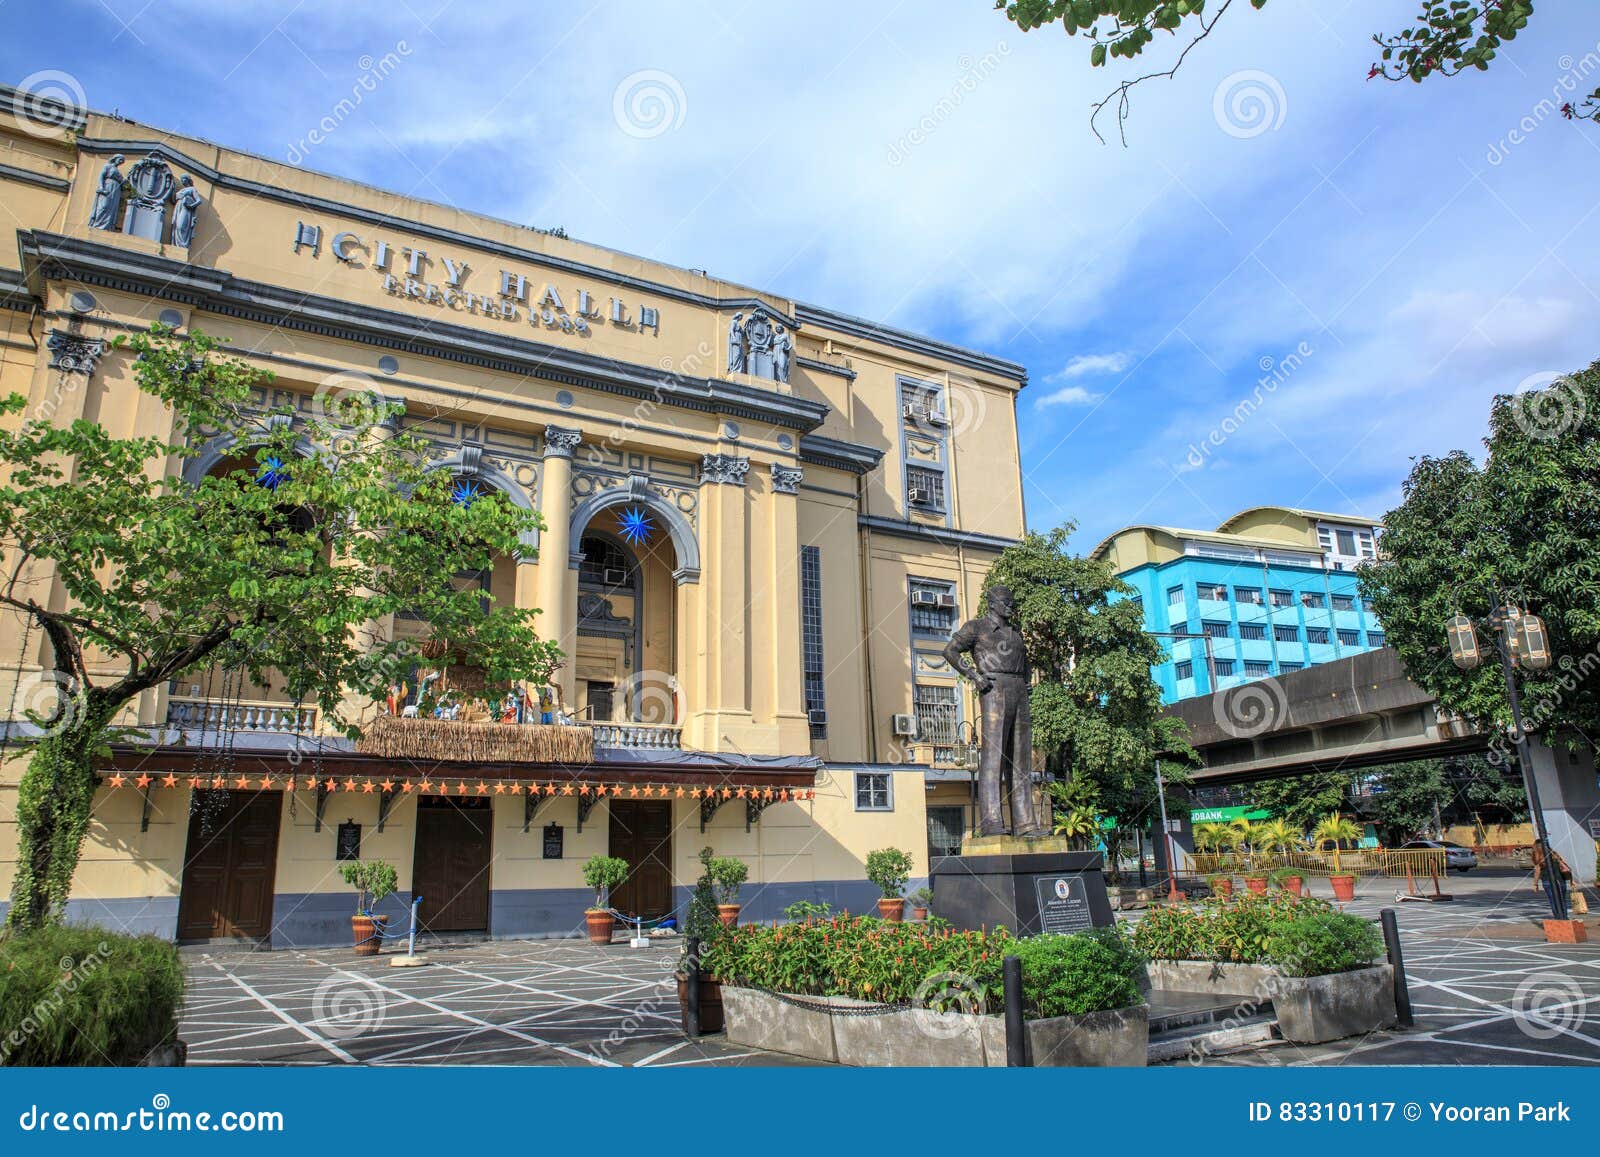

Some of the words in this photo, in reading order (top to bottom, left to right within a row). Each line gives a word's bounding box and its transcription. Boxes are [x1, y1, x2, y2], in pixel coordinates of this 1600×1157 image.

[331, 231, 470, 286] CITY
[499, 269, 632, 326] HALL
[382, 274, 518, 320] ERECTED
[528, 305, 588, 332] 1939
